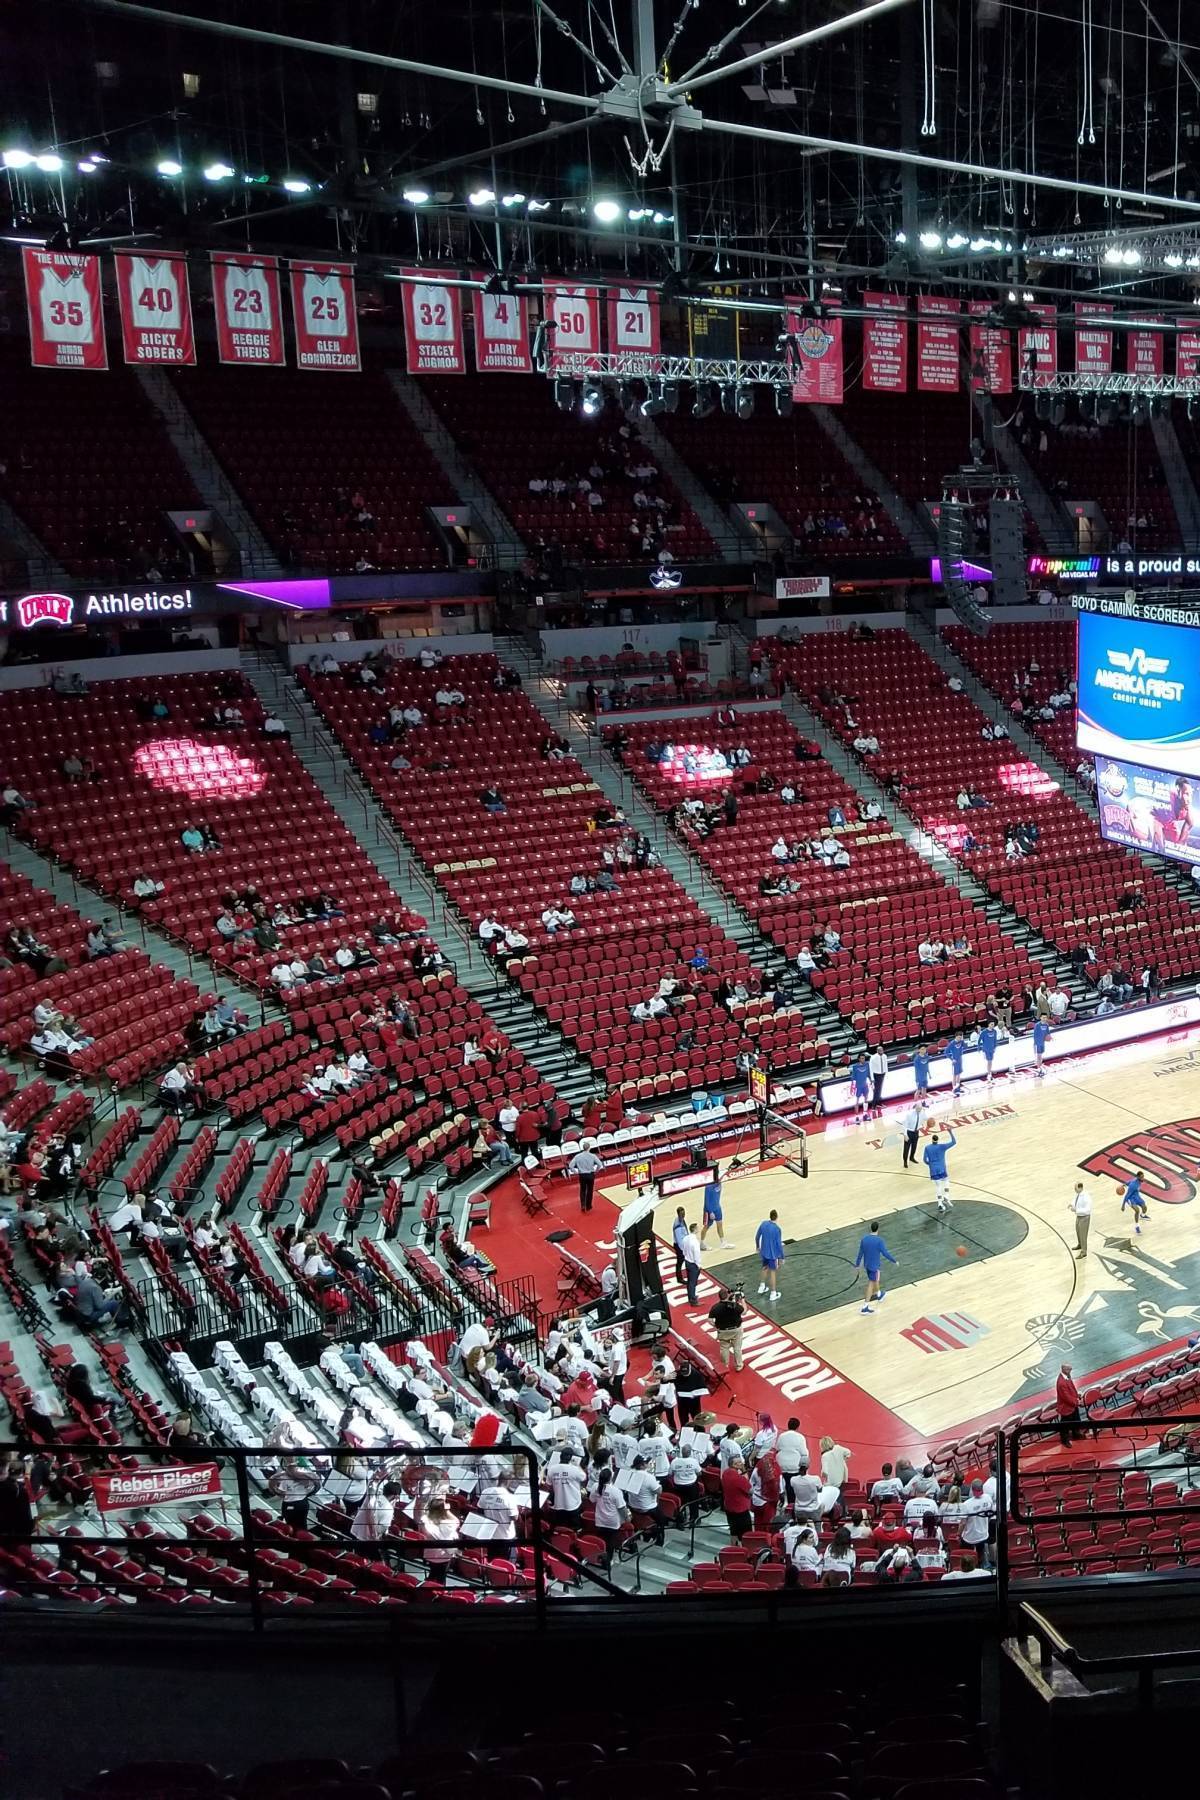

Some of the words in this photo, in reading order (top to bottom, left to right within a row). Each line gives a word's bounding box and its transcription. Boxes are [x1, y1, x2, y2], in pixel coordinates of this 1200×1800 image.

[138, 288, 173, 312] 40
[233, 288, 263, 313] 23
[50, 300, 83, 326] 35
[311, 296, 340, 320] 25
[420, 303, 446, 326] 32
[495, 303, 509, 324] 4
[560, 312, 585, 334] 50
[624, 312, 644, 333] 21
[141, 333, 176, 346] RICKY
[232, 333, 270, 346] REGGIE
[138, 347, 184, 359] SOBERS
[235, 346, 270, 358] THEUS
[419, 345, 455, 356] STACEY
[488, 343, 518, 355] LARRY
[1086, 345, 1102, 359] WAC
[1138, 350, 1153, 361] WAC
[301, 353, 357, 365] GONDREZICK
[418, 357, 459, 368] AUGMON
[484, 355, 526, 367] JOHNSON
[1030, 557, 1100, 574] Peppermill
[1107, 557, 1120, 573] is
[1124, 560, 1134, 573] a
[1139, 557, 1181, 575] proud
[18, 593, 73, 627] UNLV
[86, 590, 192, 615] Athletics!
[1072, 596, 1097, 610] BOYD
[1100, 600, 1140, 617] GAMING
[622, 628, 642, 642] 117
[1095, 668, 1145, 695] AMERICA
[1146, 679, 1184, 702] FIRST
[1112, 692, 1137, 704] CREDIT
[1139, 698, 1162, 709] UNION
[631, 1172, 648, 1186] 30
[110, 1475, 158, 1492] Rebel
[163, 1470, 212, 1488] Place
[107, 1494, 150, 1504] Student
